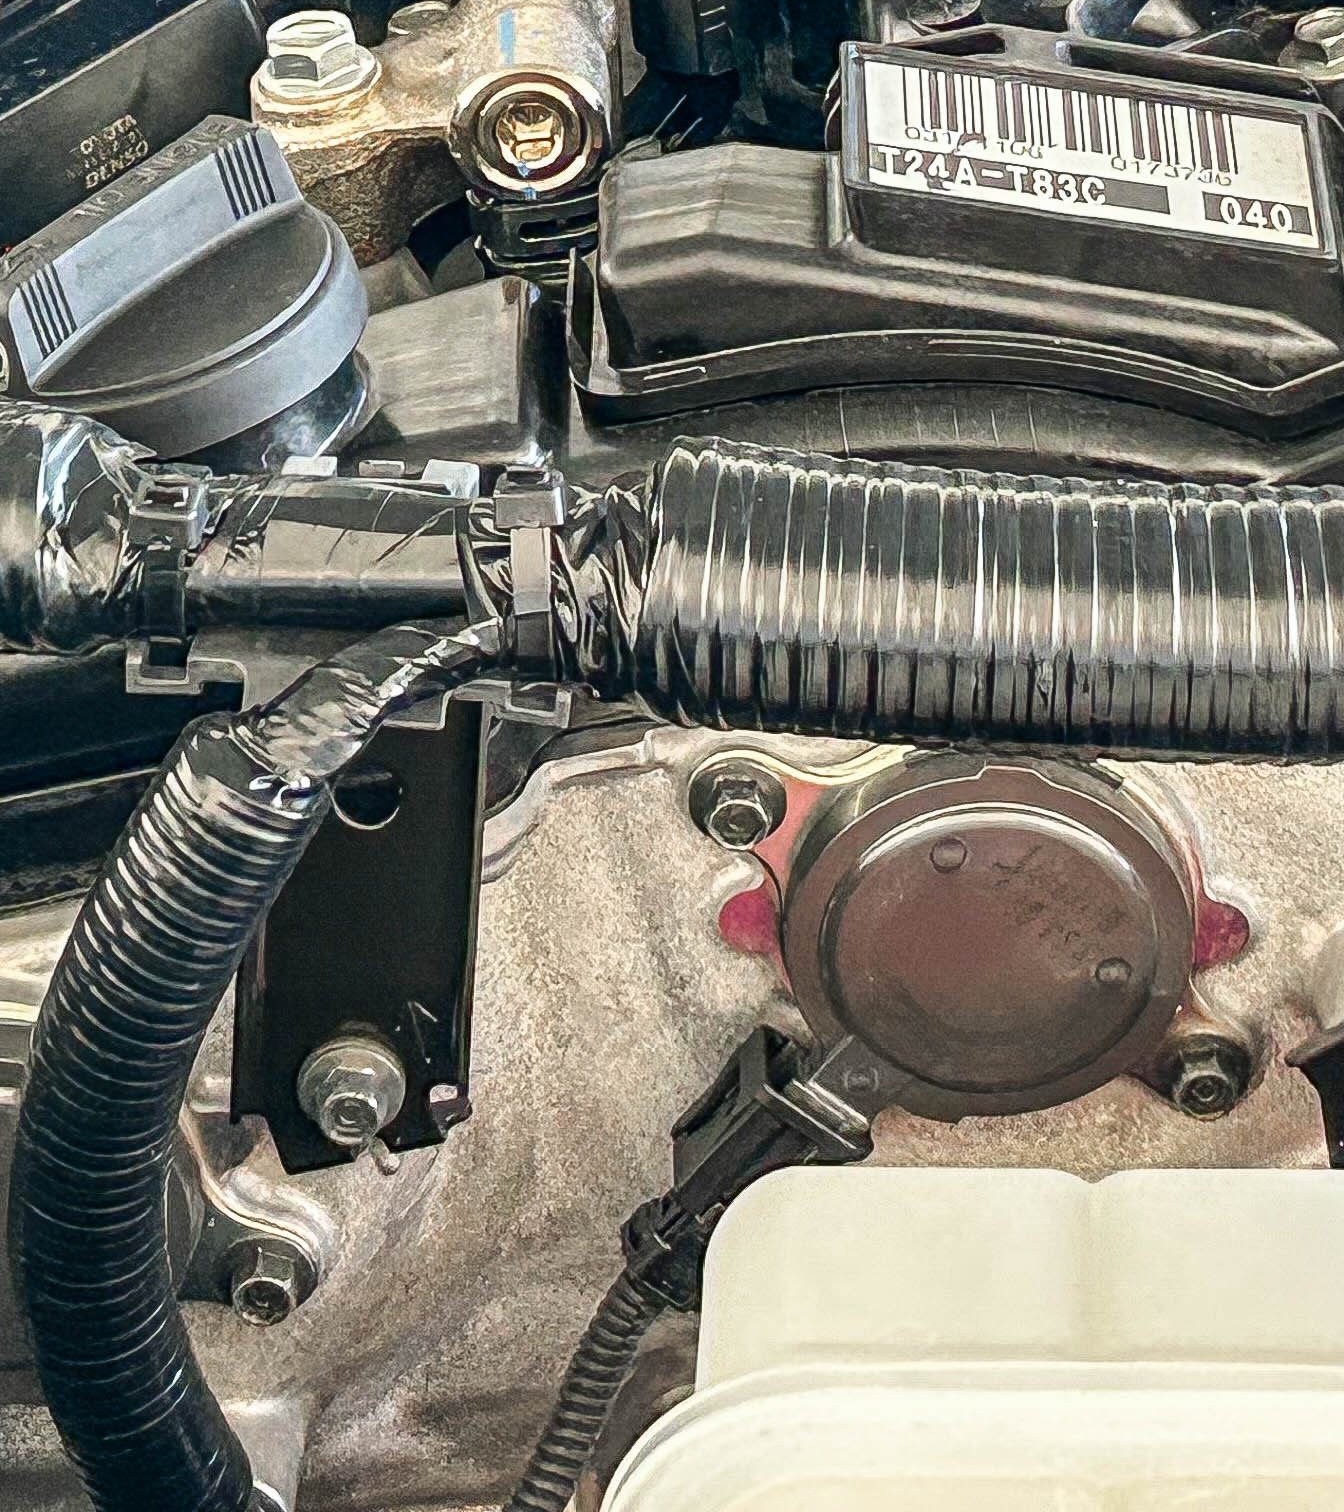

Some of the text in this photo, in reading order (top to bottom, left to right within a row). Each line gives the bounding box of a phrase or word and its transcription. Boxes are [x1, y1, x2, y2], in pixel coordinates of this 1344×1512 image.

[68, 113, 137, 156] OYOTA
[877, 144, 1293, 233] T24A-T83C 040
